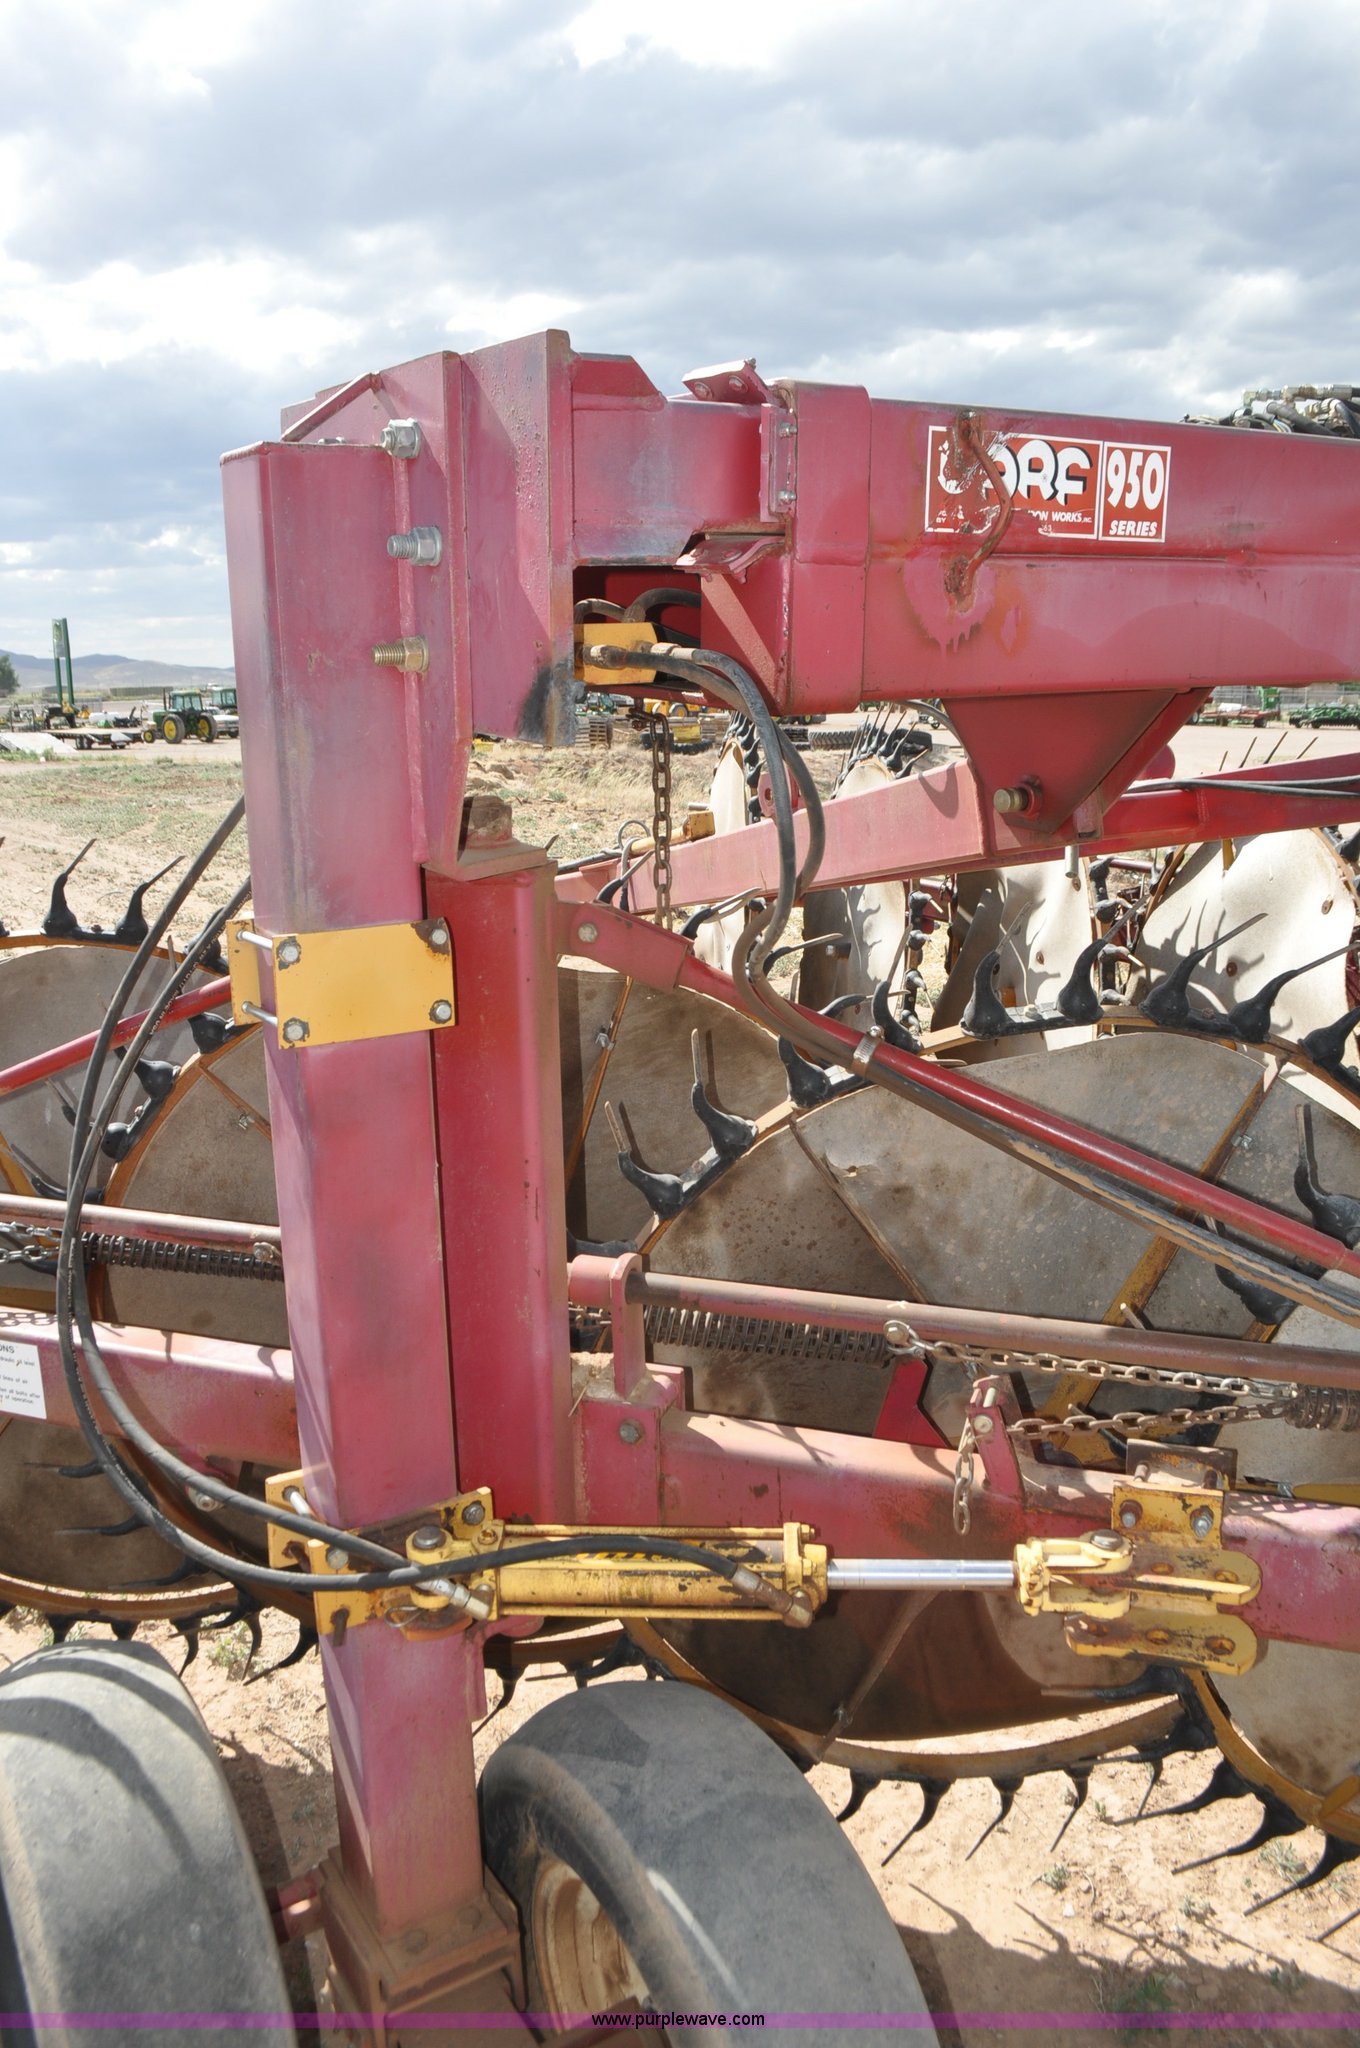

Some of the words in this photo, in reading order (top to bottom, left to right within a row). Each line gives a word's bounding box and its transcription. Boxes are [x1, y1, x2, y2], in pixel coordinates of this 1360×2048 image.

[1107, 449, 1164, 511] 950
[1051, 511, 1082, 523] WORKS
[1109, 520, 1158, 537] SERIES
